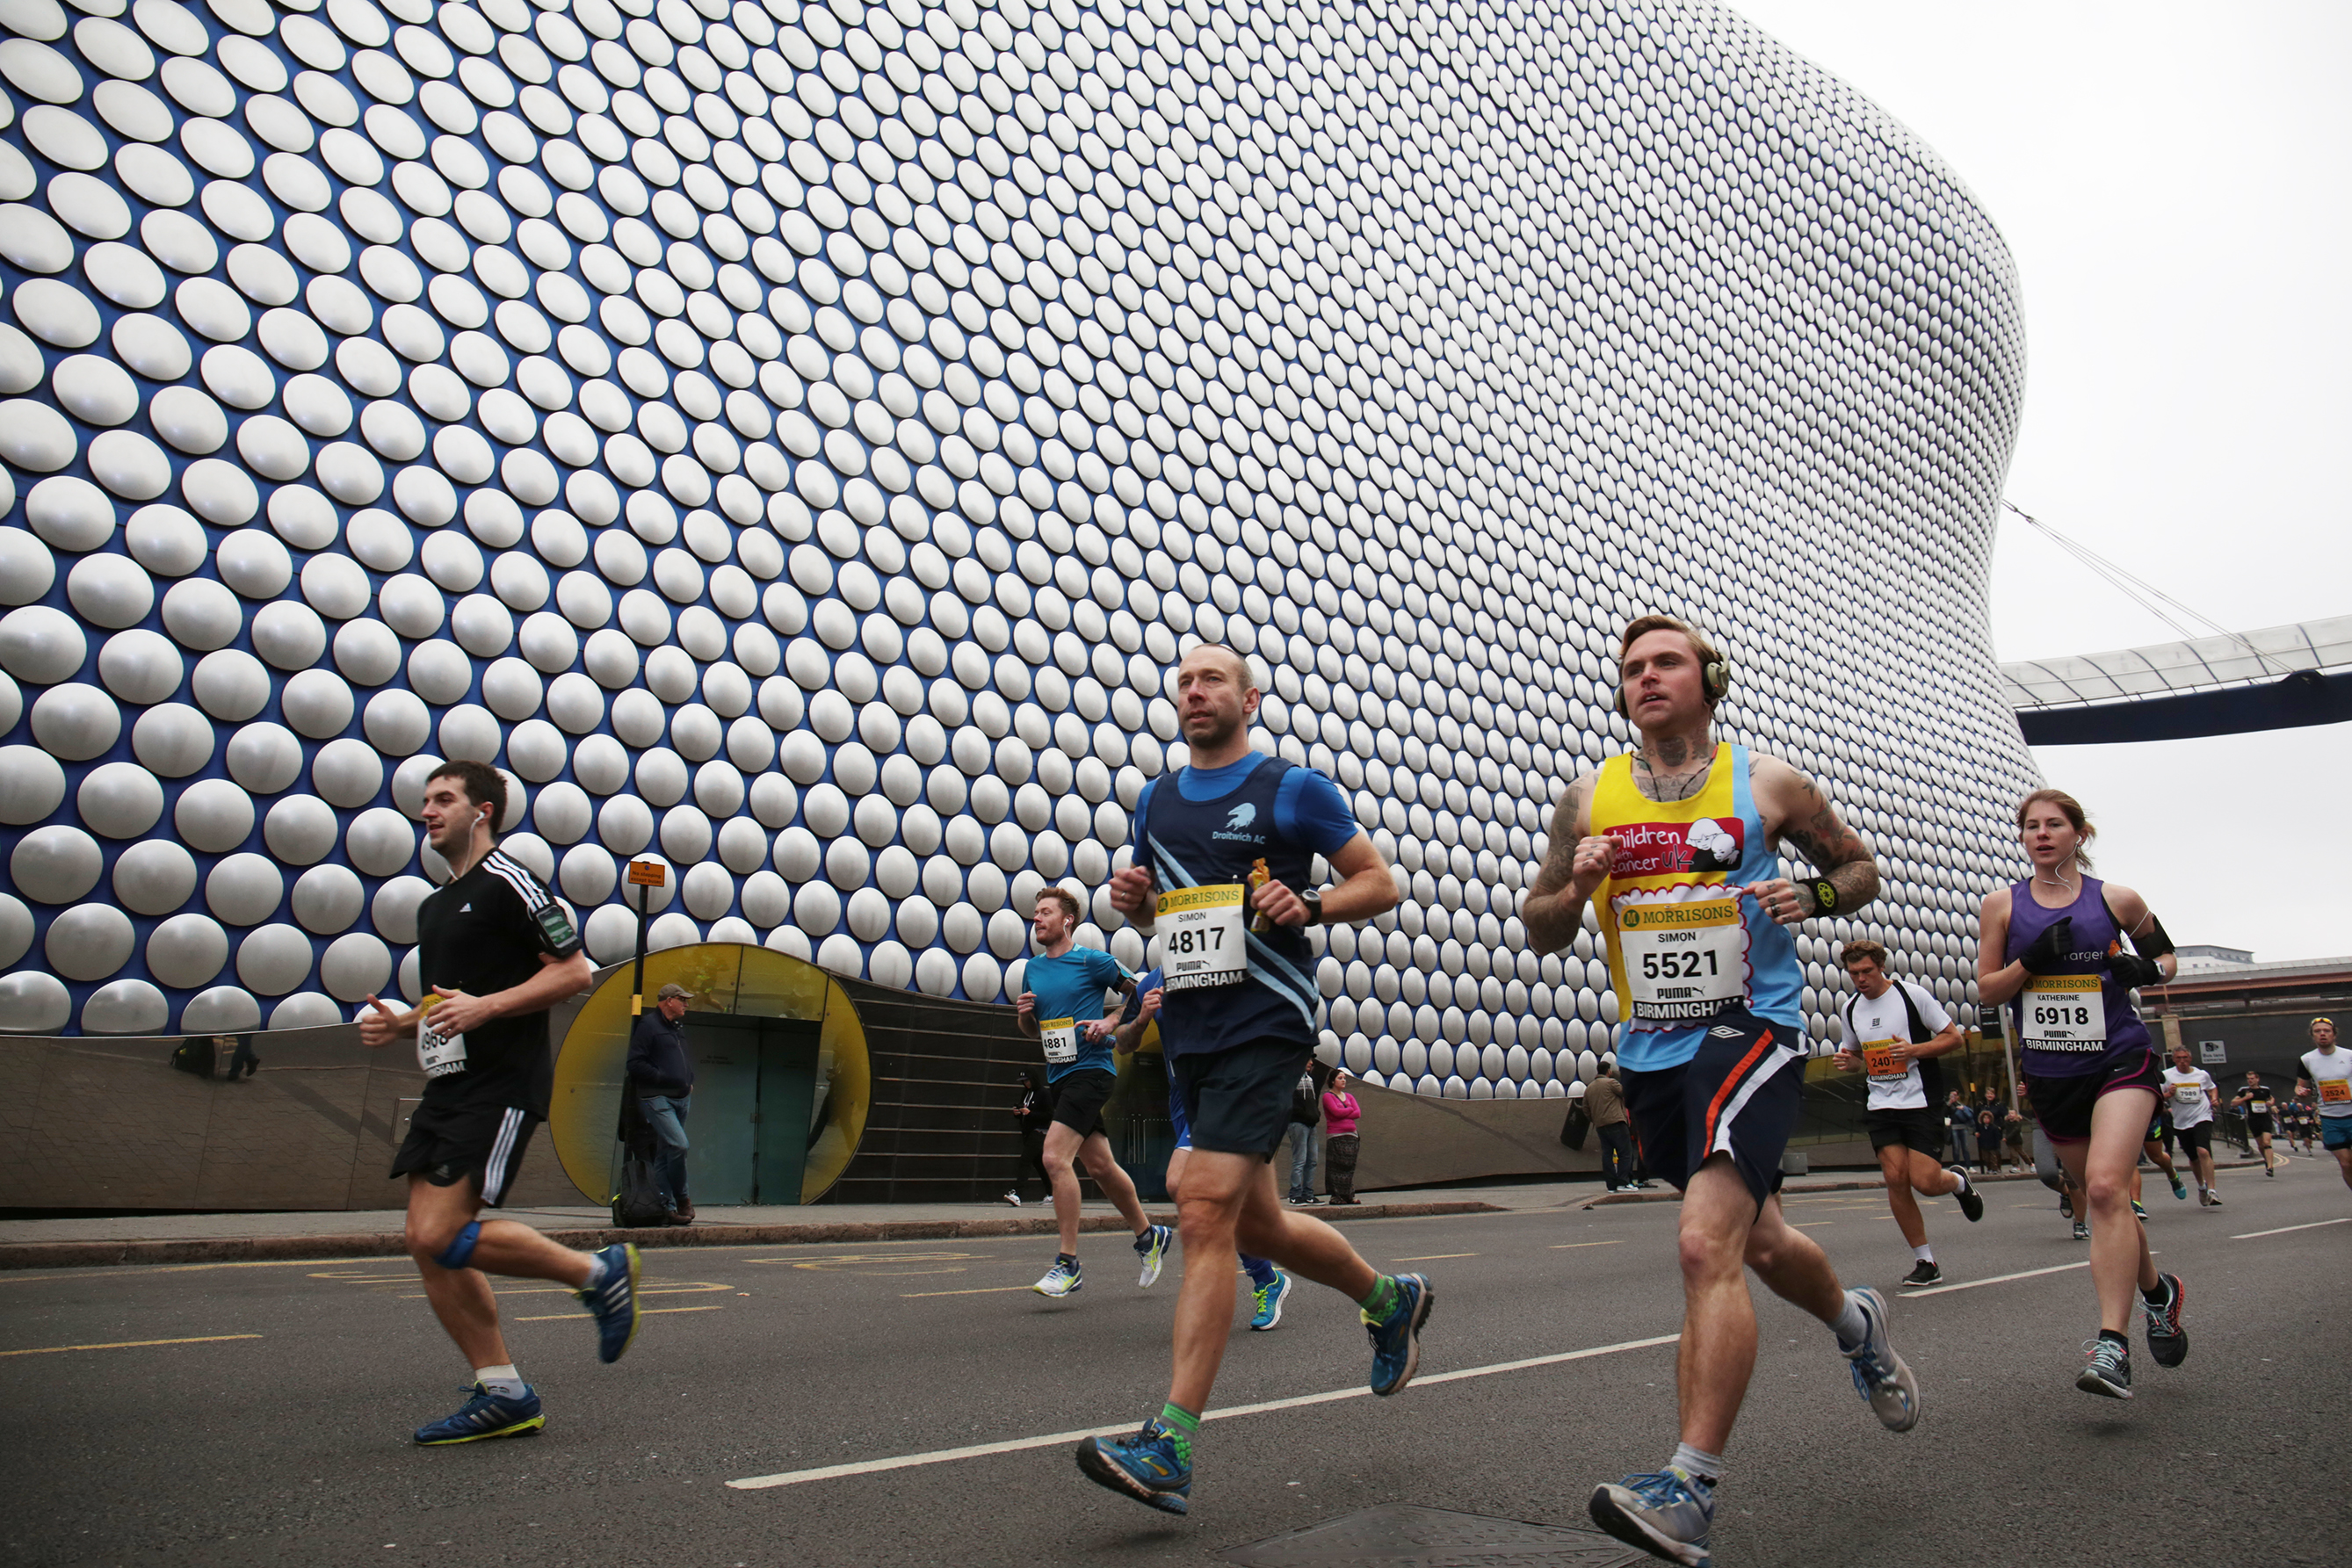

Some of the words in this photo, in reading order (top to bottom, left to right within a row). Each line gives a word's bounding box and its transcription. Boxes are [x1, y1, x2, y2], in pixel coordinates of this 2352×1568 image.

[1212, 830, 1252, 843] Droitwich
[1253, 834, 1265, 845] AC
[1613, 825, 1681, 849] hildren
[1610, 856, 1660, 874] cancer
[1169, 890, 1240, 907] MORRISONS
[1178, 912, 1206, 922] SIMON
[1643, 906, 1733, 925] MORRISONS
[1168, 927, 1225, 955] 4817
[1658, 932, 1697, 943] SIMON
[1176, 959, 1202, 972] PUMA
[1643, 950, 1718, 979] 5521
[2035, 978, 2098, 989] MORRISONS
[1657, 986, 1692, 1000] PUMA
[2035, 1007, 2089, 1025] 6918
[2044, 1030, 2067, 1038] PUMA
[1044, 1037, 1067, 1049] 4881
[2026, 1039, 2104, 1051] BIRMINGHAM
